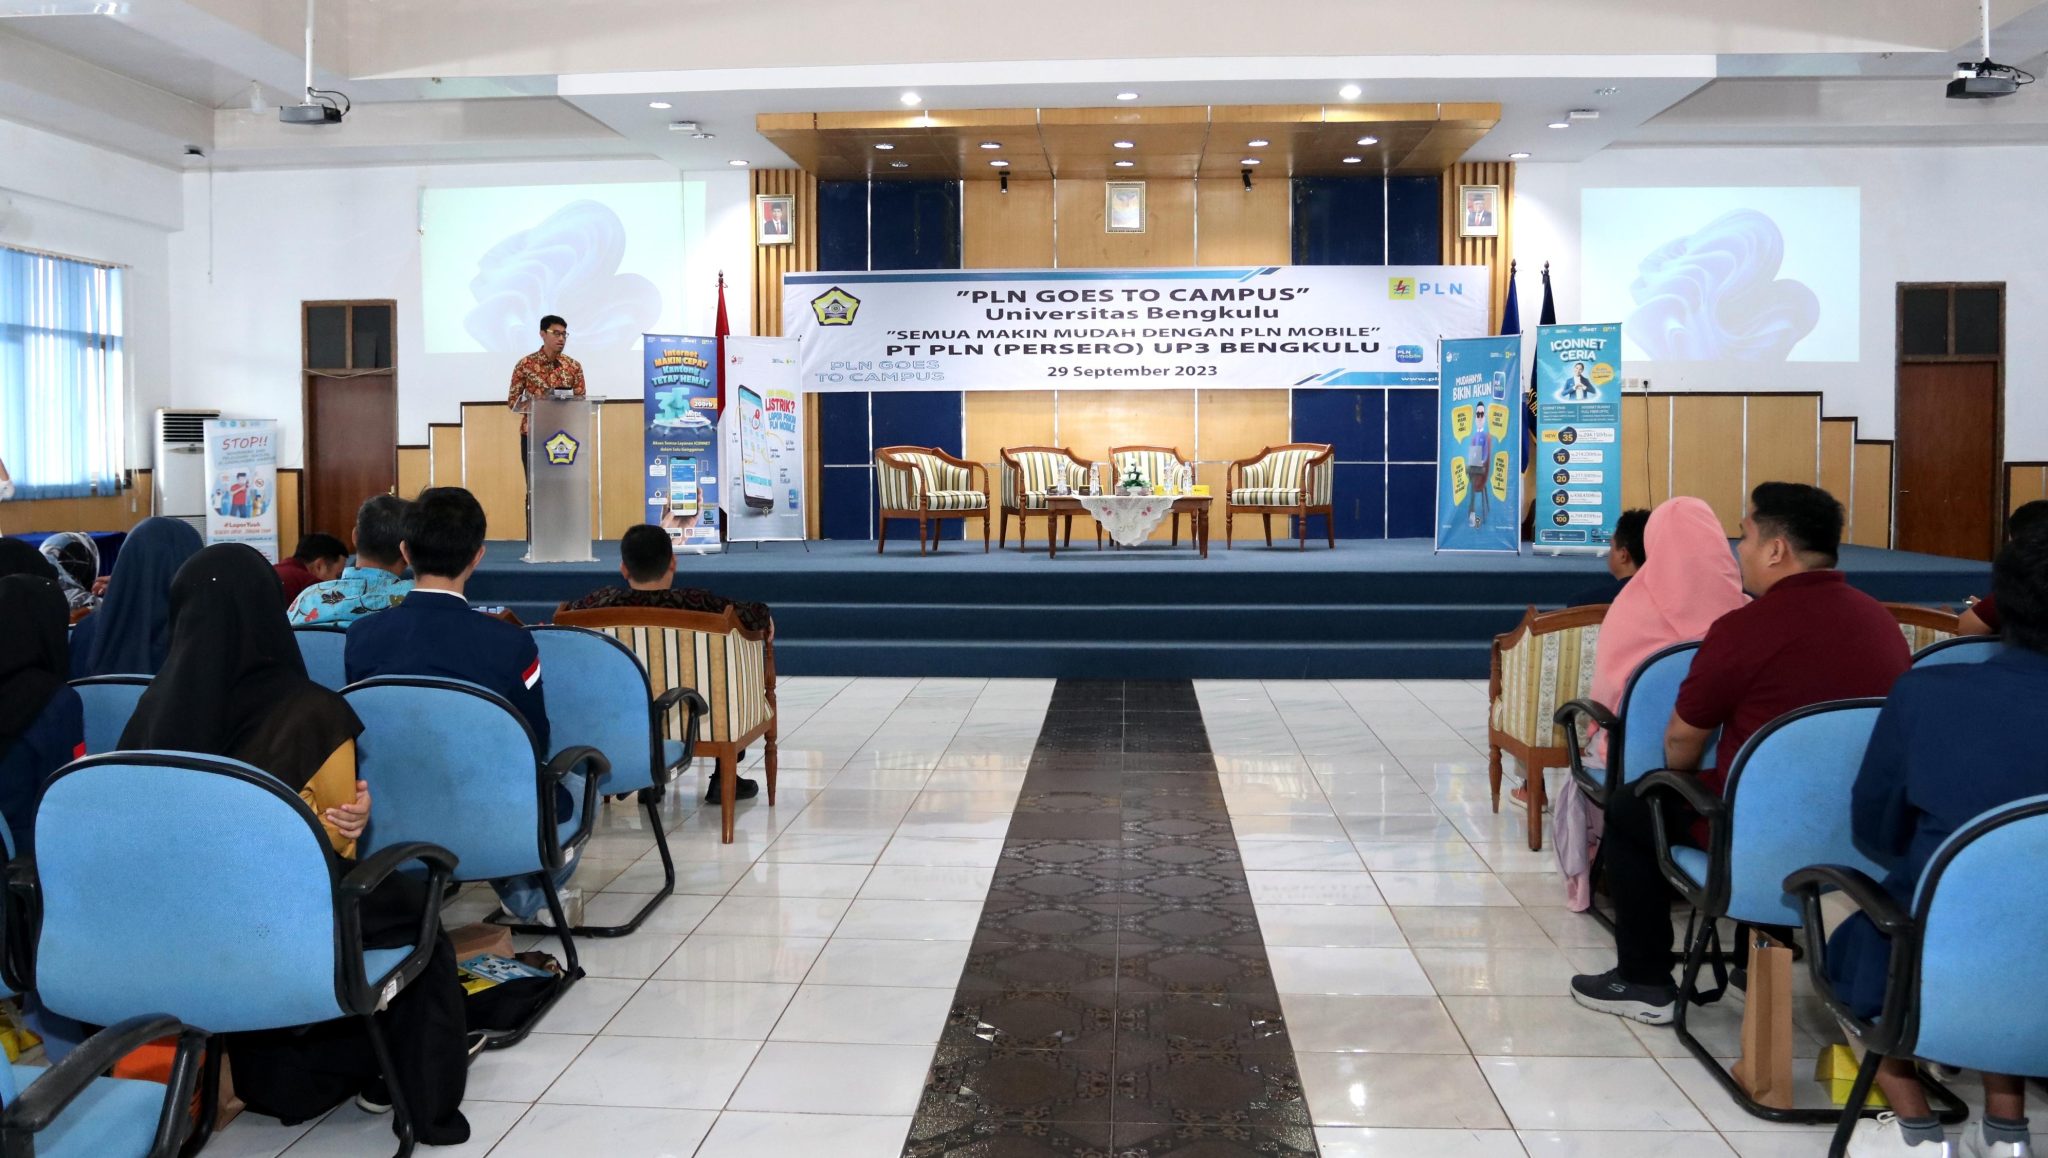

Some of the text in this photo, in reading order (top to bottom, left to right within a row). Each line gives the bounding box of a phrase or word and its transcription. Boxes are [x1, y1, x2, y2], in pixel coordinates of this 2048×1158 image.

[1419, 283, 1464, 295] PLN
[1035, 289, 1114, 303] GOES
[1121, 289, 1160, 302] TO
[985, 306, 1279, 322] Universitas Bengkulu
[976, 329, 1049, 339] MAKIN
[1054, 328, 1136, 339] MUDAH
[1142, 327, 1234, 338] DENGAN
[1240, 327, 1282, 337] PLN
[886, 341, 1380, 357] PT PLN (PERSERO) UP3 BENGKULU
[1549, 338, 1607, 352] ICONNET
[663, 349, 699, 358] Internet
[1560, 350, 1596, 361] CERIA
[654, 357, 708, 369] MAKIN CEPAT
[829, 360, 941, 371] PLN GOES
[662, 365, 701, 377] Kantong
[814, 371, 945, 383] TO CAMPUS
[1047, 365, 1218, 380] 29 September 2023
[651, 375, 711, 388] TETAP HEMAT
[1455, 373, 1483, 386] MUDAHNYA
[1452, 382, 1492, 401] BIKIN AKUN
[654, 387, 690, 420] 35
[222, 436, 268, 450] STOP!!
[1562, 433, 1574, 442] 35
